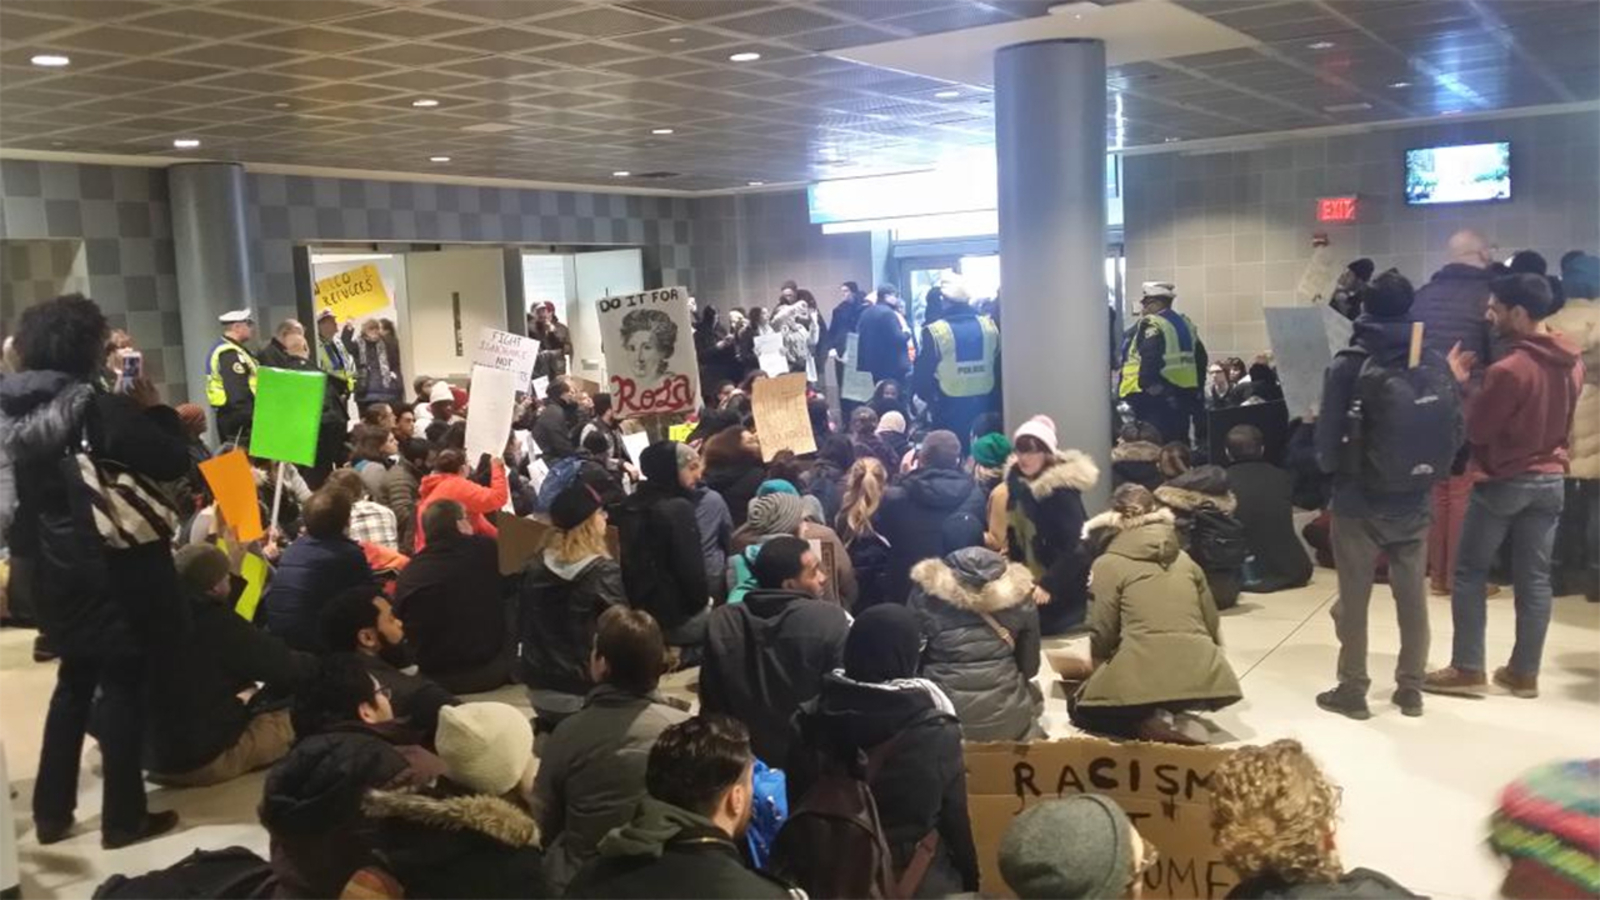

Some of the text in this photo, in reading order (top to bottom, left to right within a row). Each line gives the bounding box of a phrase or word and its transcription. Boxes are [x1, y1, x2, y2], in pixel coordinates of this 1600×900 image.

[1321, 200, 1351, 219] EXIT
[599, 289, 678, 313] DO IT FOR
[495, 356, 513, 367] NOT
[1013, 757, 1217, 800] RACISM
